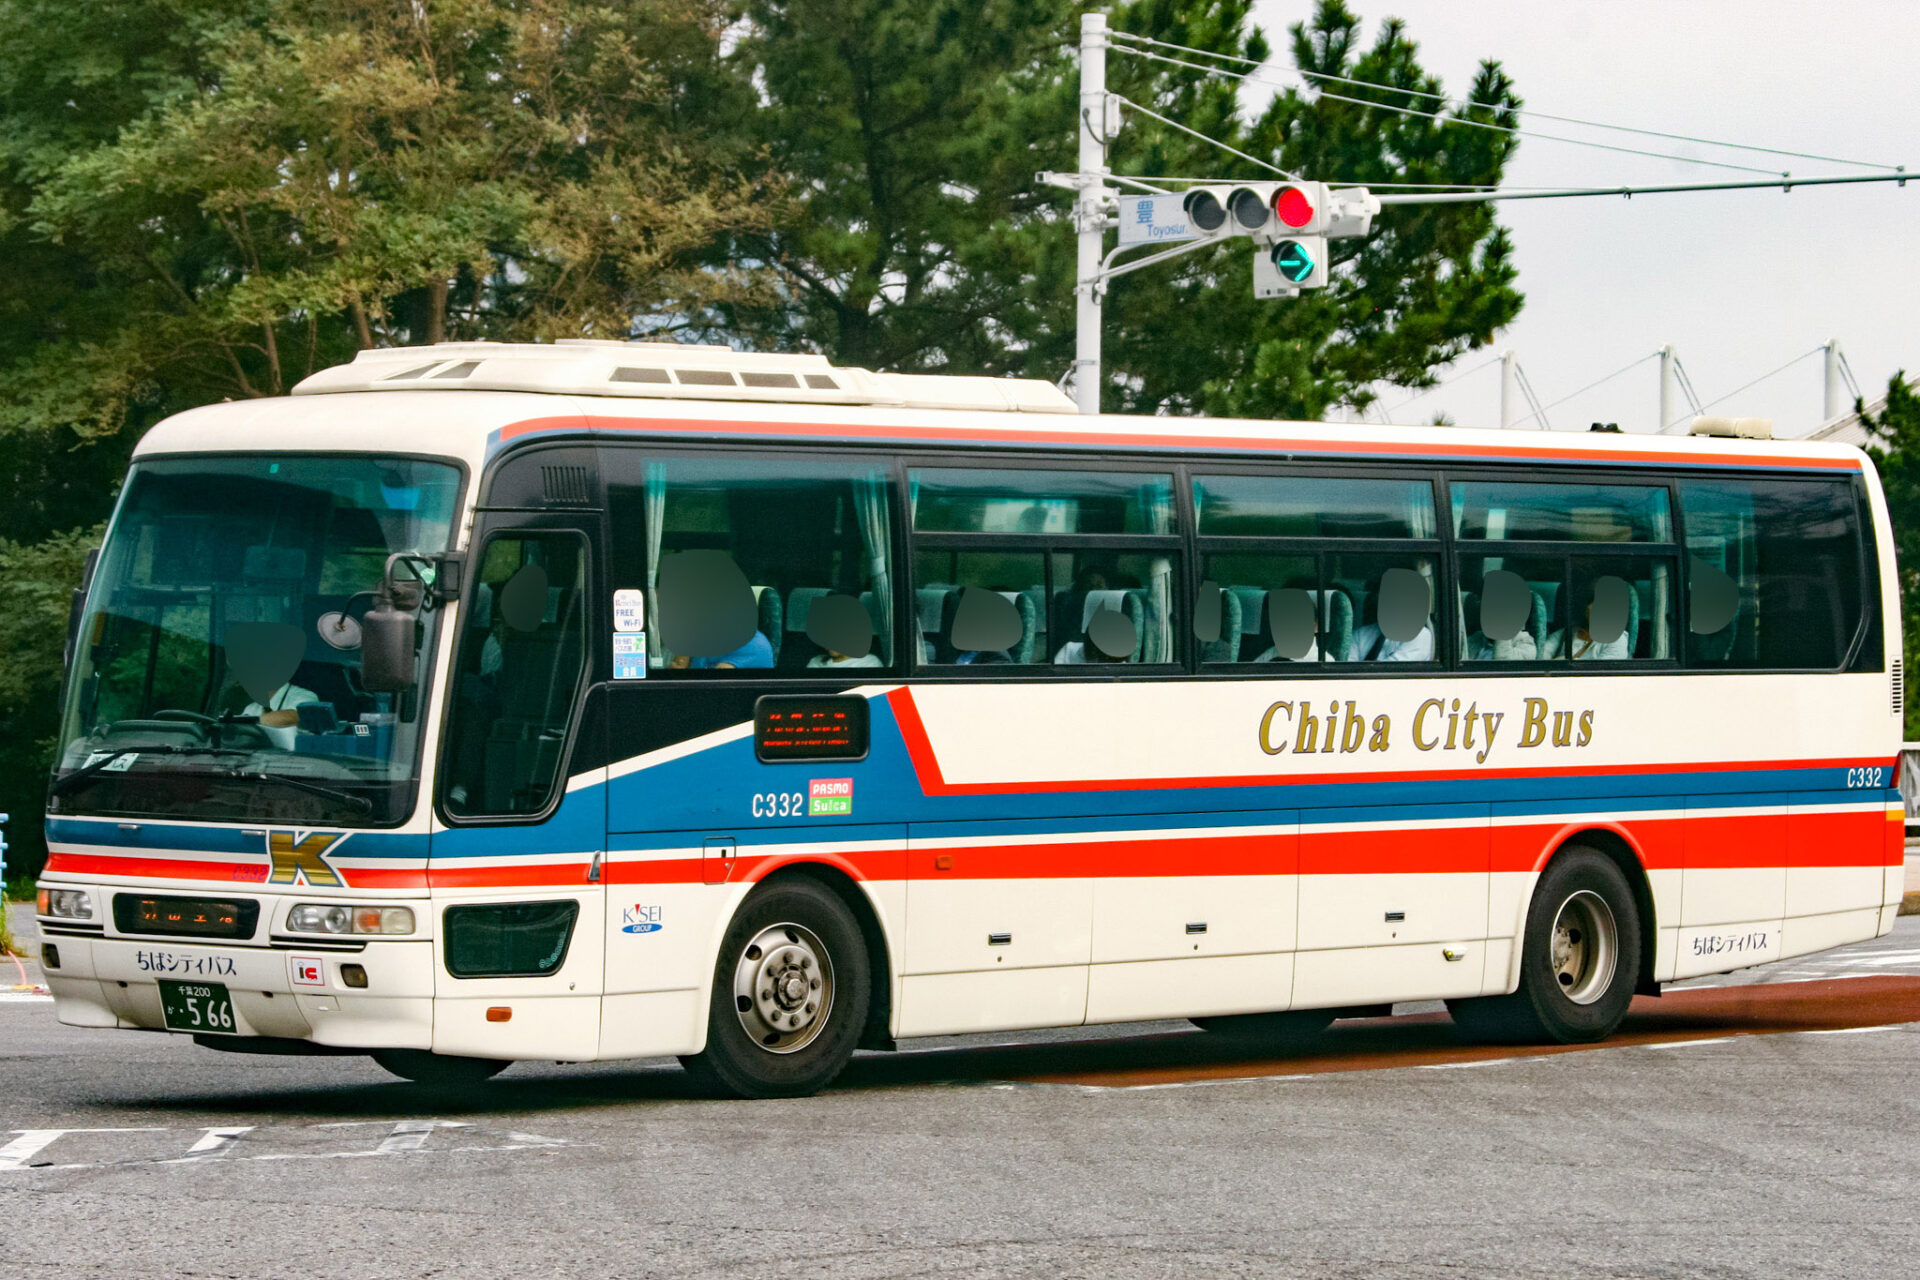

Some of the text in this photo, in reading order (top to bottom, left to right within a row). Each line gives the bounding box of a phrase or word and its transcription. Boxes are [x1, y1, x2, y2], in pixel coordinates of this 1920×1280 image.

[615, 609, 634, 617] FREE
[623, 619, 641, 627] Wi-Fi
[1258, 697, 1595, 764] Chiba City Bus
[1847, 767, 1882, 788] C332
[812, 782, 849, 795] PASMO
[752, 792, 803, 818] C332
[813, 799, 847, 812] Suica
[268, 829, 345, 888] K
[233, 864, 268, 881] C332
[632, 924, 653, 933] GROUP
[1693, 932, 1767, 956] ちばシティバス
[135, 951, 237, 976] ちばシティバス
